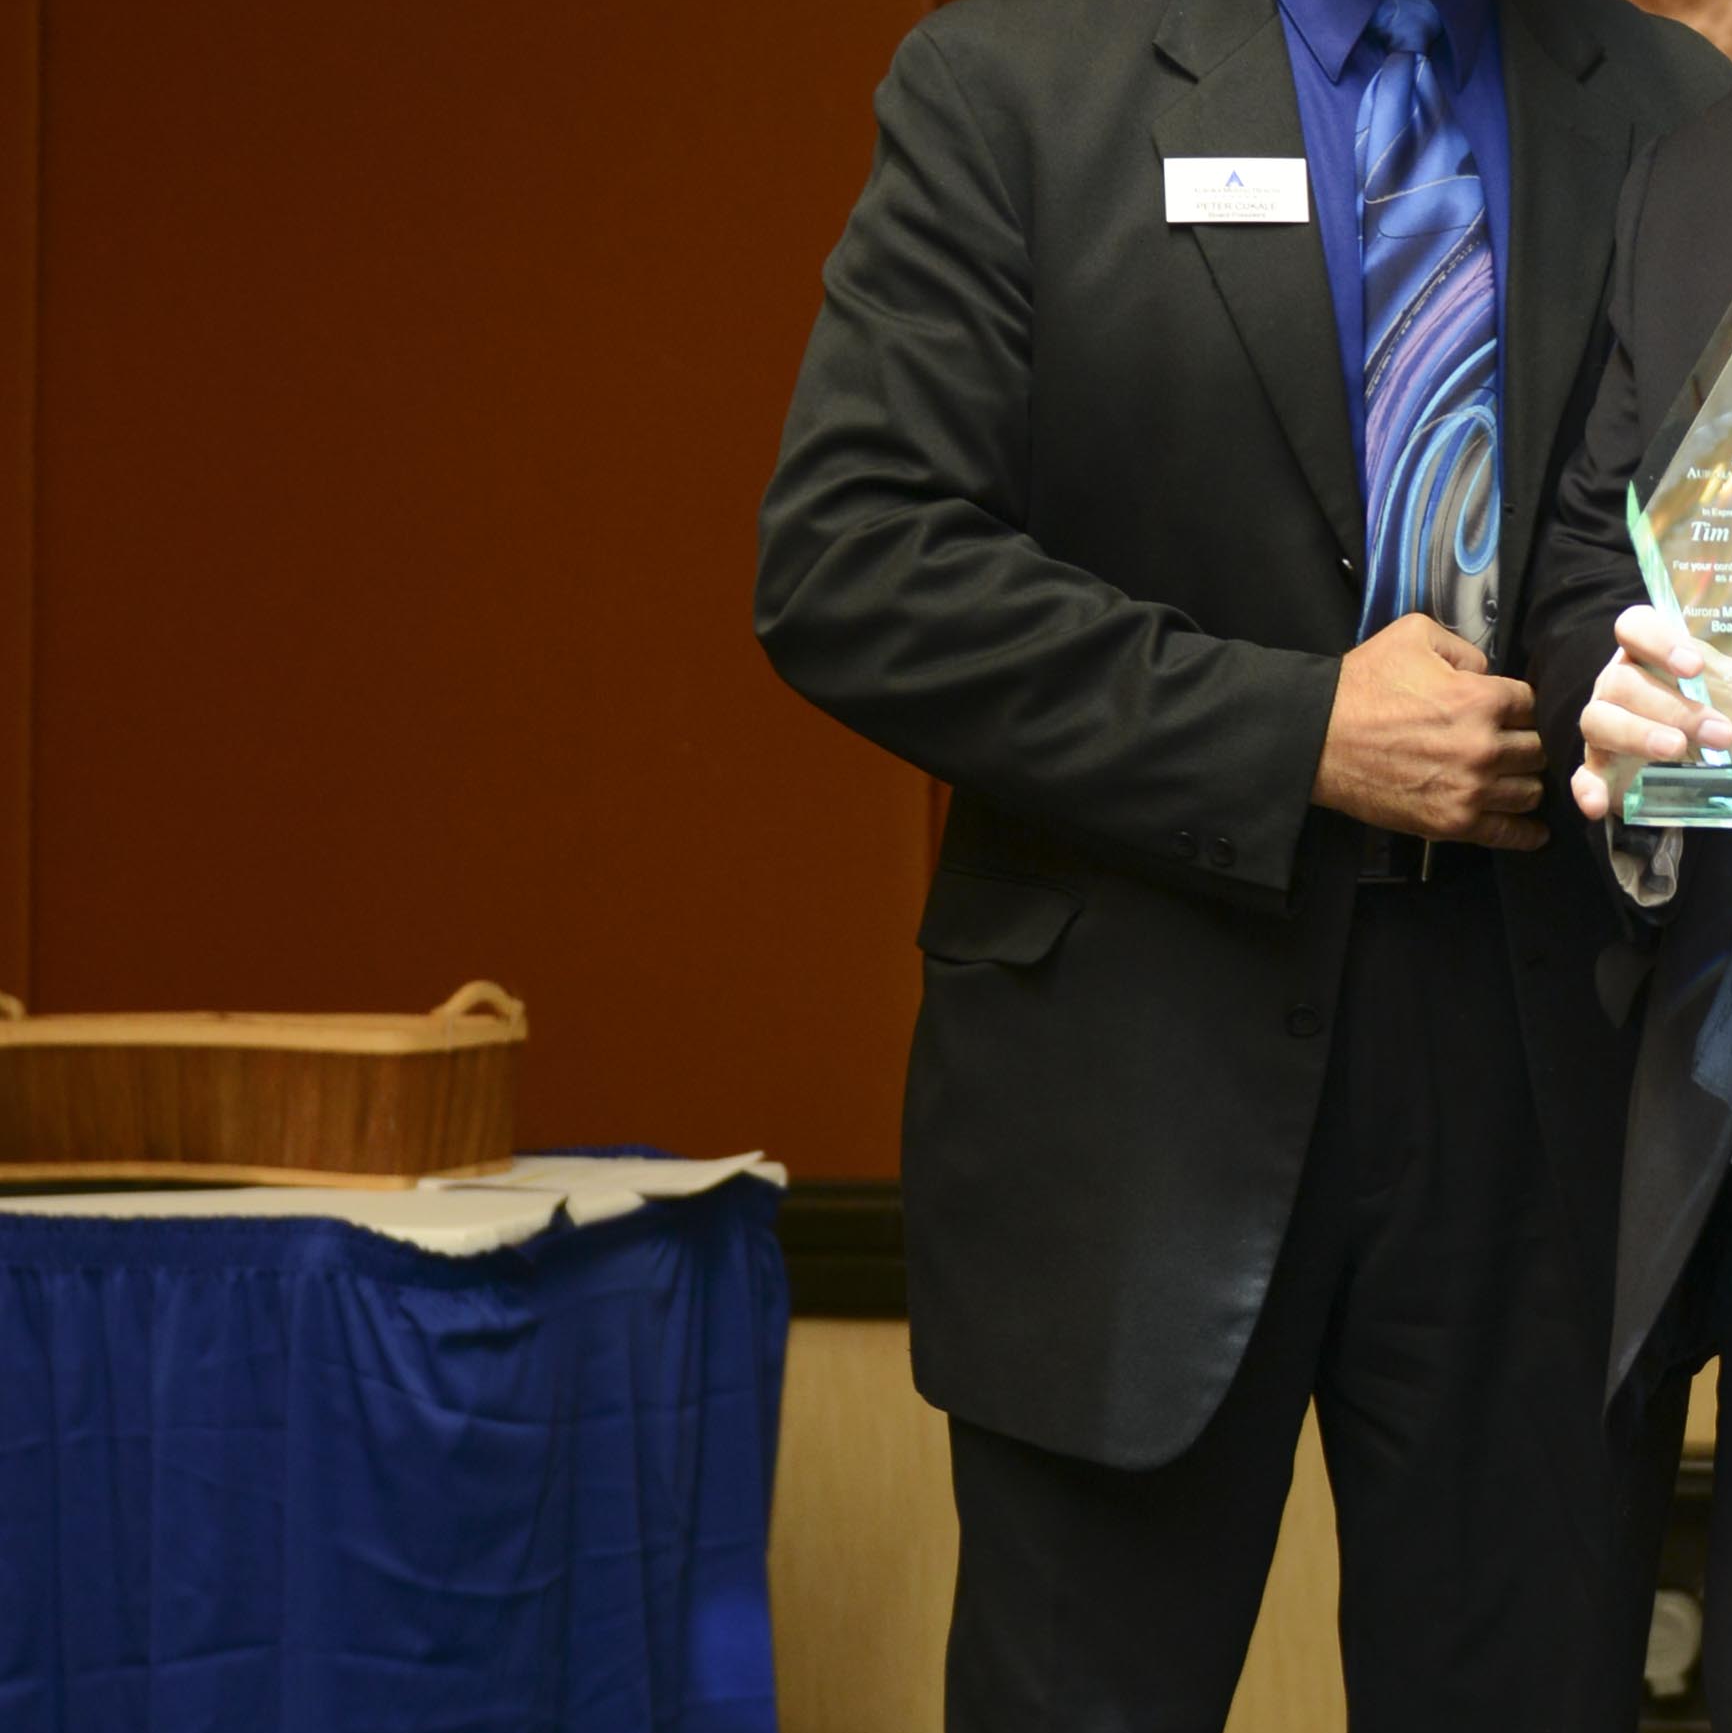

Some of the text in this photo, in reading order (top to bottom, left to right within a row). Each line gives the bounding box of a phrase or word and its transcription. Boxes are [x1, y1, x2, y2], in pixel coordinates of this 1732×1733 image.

[1691, 521, 1730, 543] Tim
[1672, 560, 1690, 571] For
[1691, 561, 1712, 573] your
[1682, 605, 1720, 618] Aurora
